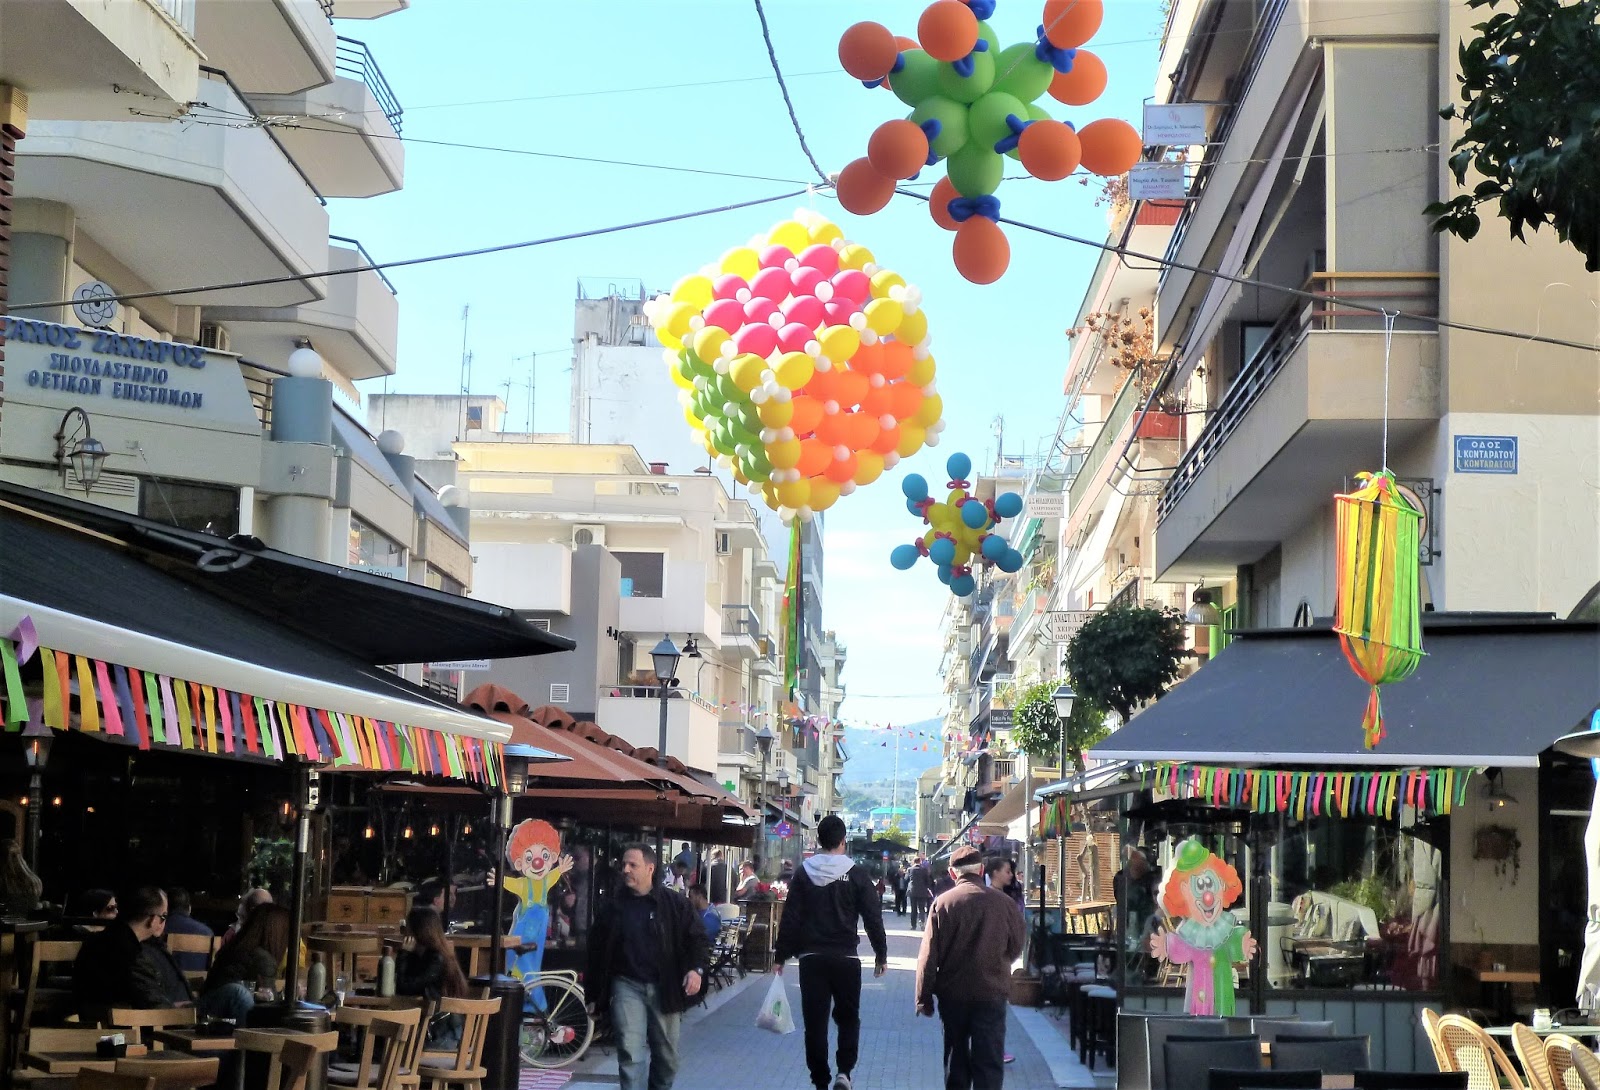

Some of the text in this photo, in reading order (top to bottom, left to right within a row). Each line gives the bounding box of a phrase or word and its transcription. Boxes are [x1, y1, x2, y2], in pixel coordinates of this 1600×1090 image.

[92, 331, 206, 369] ΖΑΧΑΡΟΣ
[50, 352, 168, 385] ΣΠΟΥΔΑΣΤΗΡΙΟ
[27, 369, 203, 408] ΘΕΤΙΚΩΝ ΕΠΙΣΤΗΜΩΝ
[1471, 441, 1500, 449] ΟΔΟΣ
